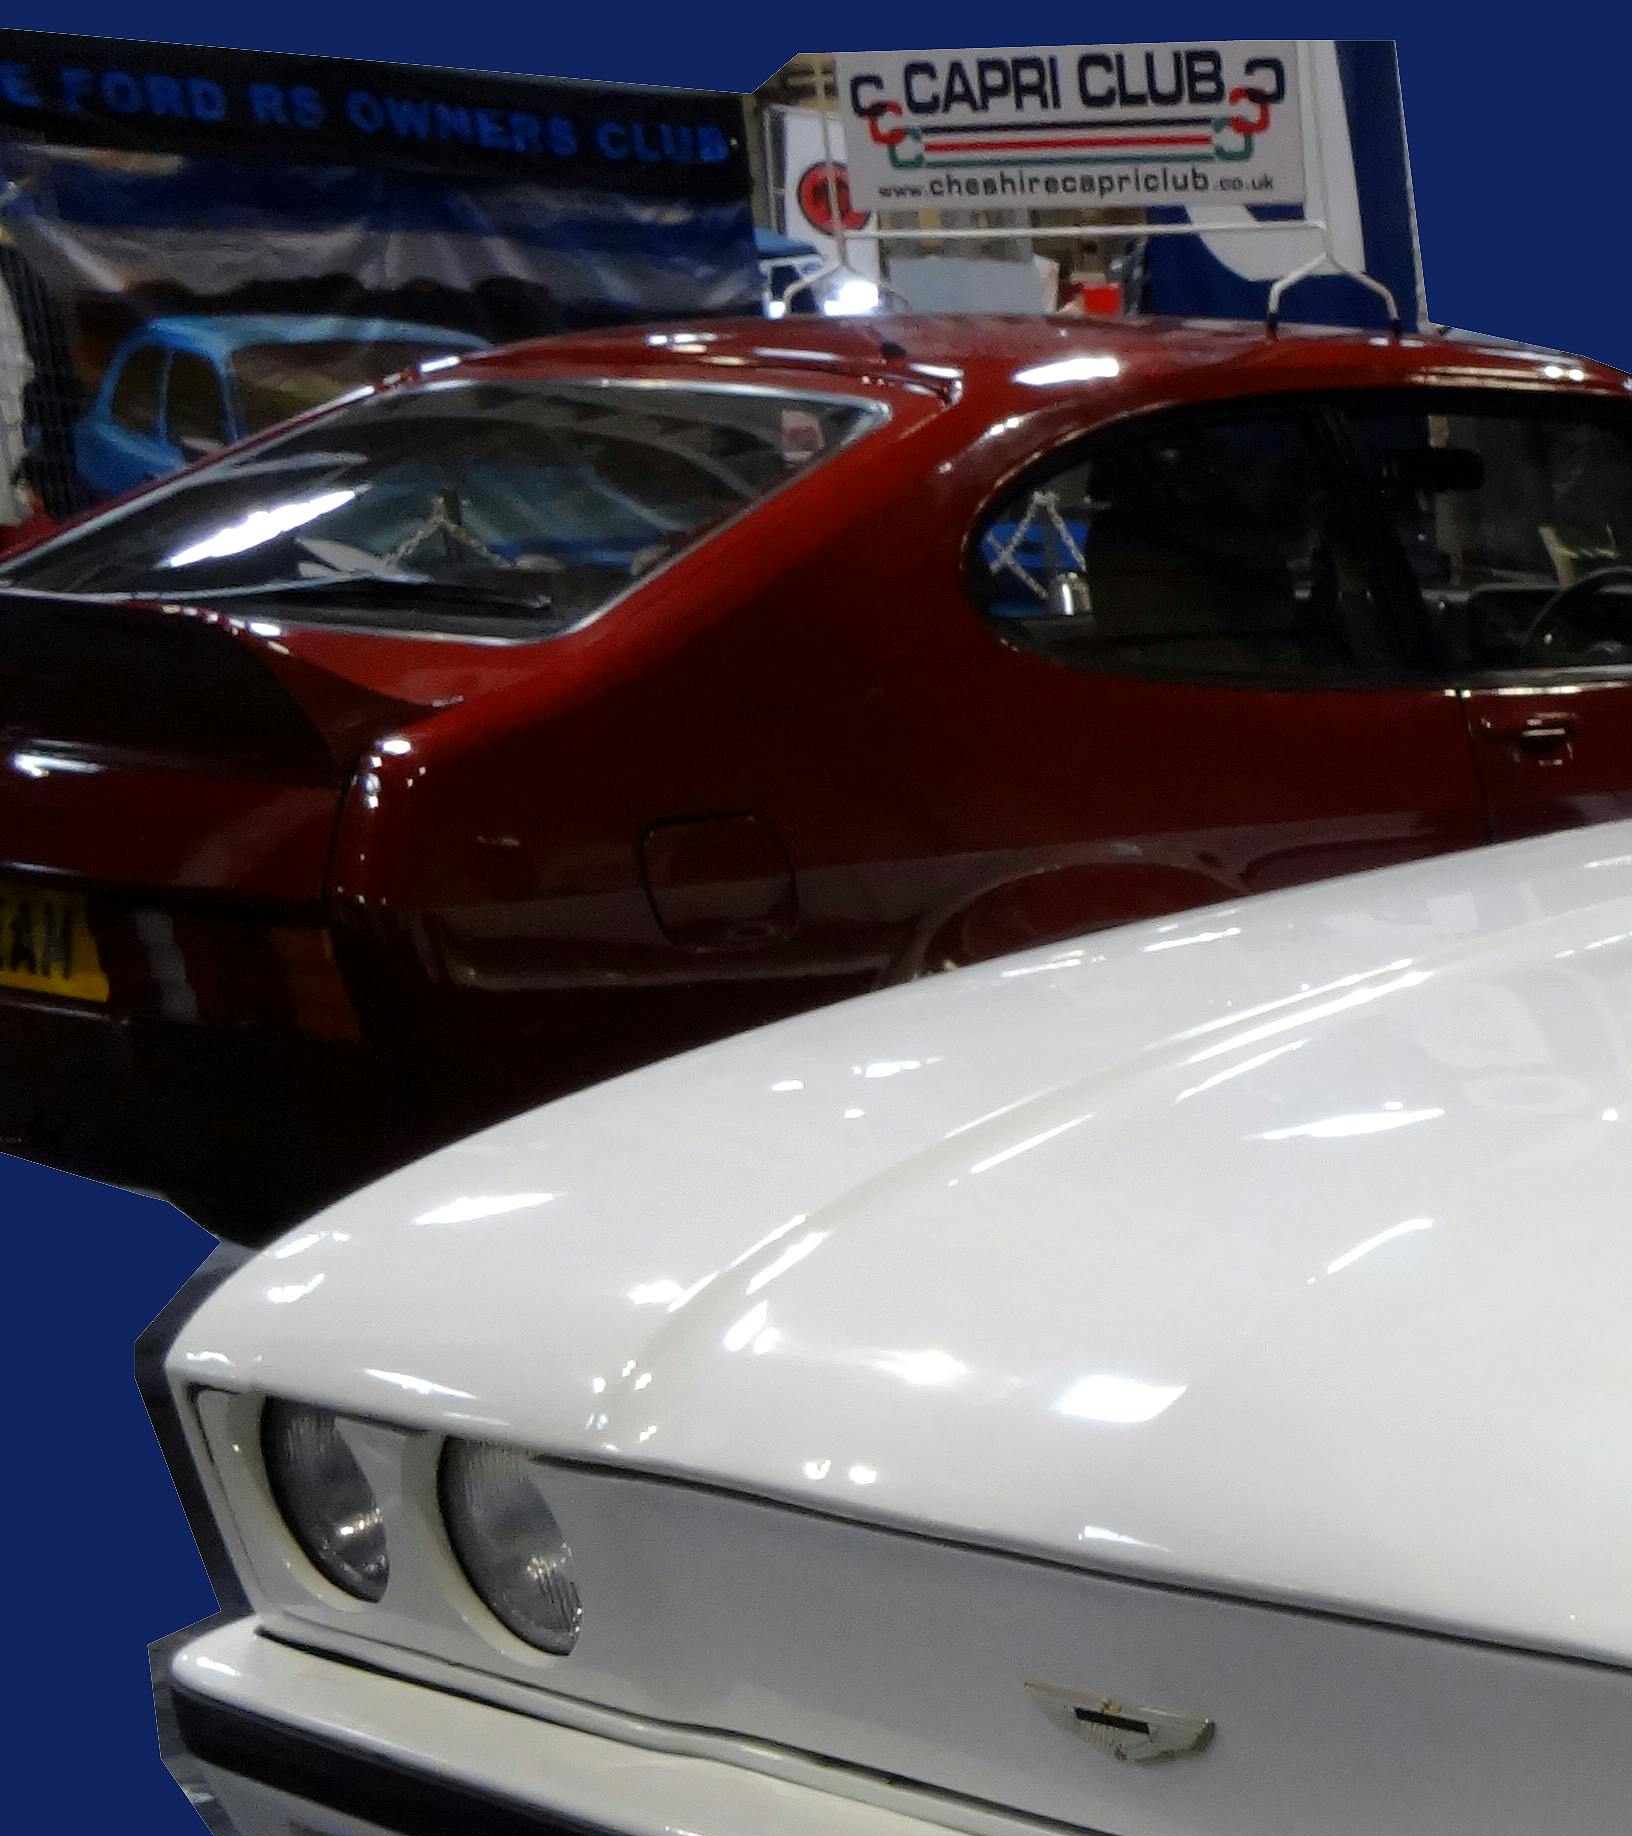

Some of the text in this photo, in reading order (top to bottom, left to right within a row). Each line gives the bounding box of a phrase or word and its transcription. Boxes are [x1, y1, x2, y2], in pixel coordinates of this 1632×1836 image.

[60, 66, 226, 123] FORD
[248, 82, 328, 129] RS
[344, 90, 579, 159] OWNERS
[594, 120, 729, 165] CLUB
[903, 49, 1226, 116] CAPRI CLUB
